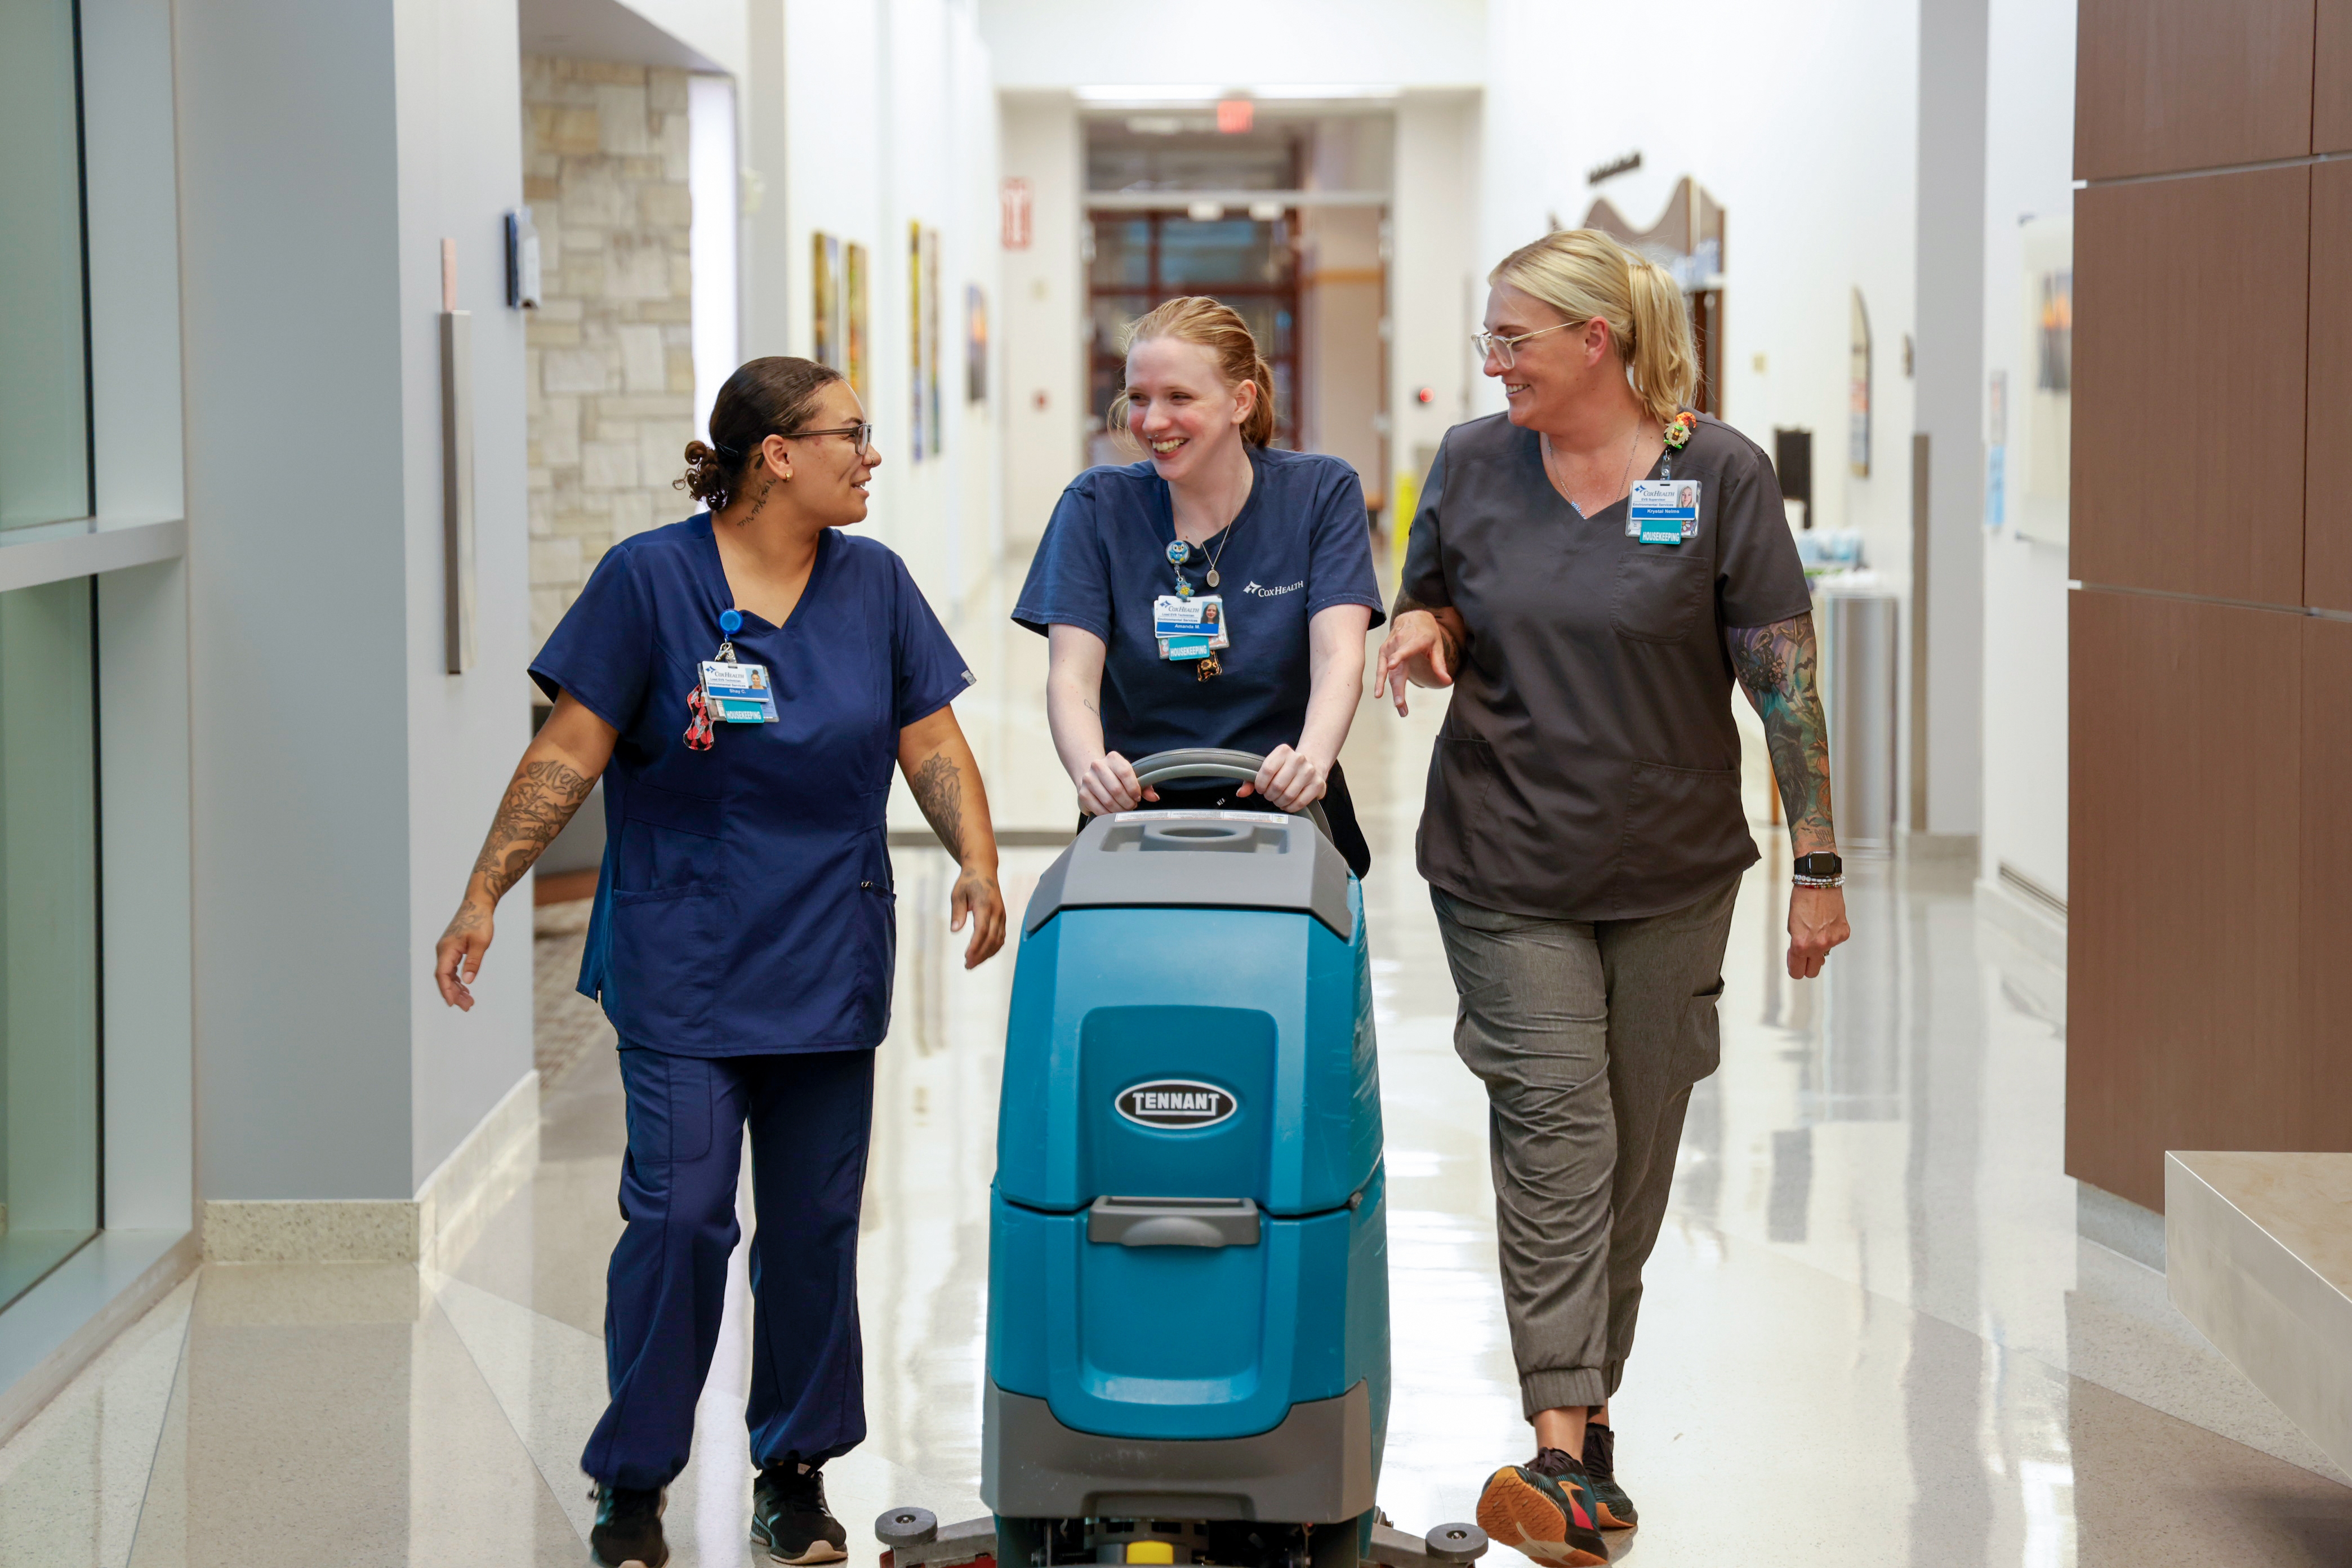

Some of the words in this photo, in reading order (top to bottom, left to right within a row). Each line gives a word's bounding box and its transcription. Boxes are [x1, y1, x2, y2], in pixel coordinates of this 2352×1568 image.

[1642, 532, 1680, 542] HOUSEKEEPING
[1170, 645, 1207, 657] HOUSEKEEPING
[726, 710, 761, 720] HOUSEKEEPING
[1132, 1092, 1220, 1116] TENNANT
